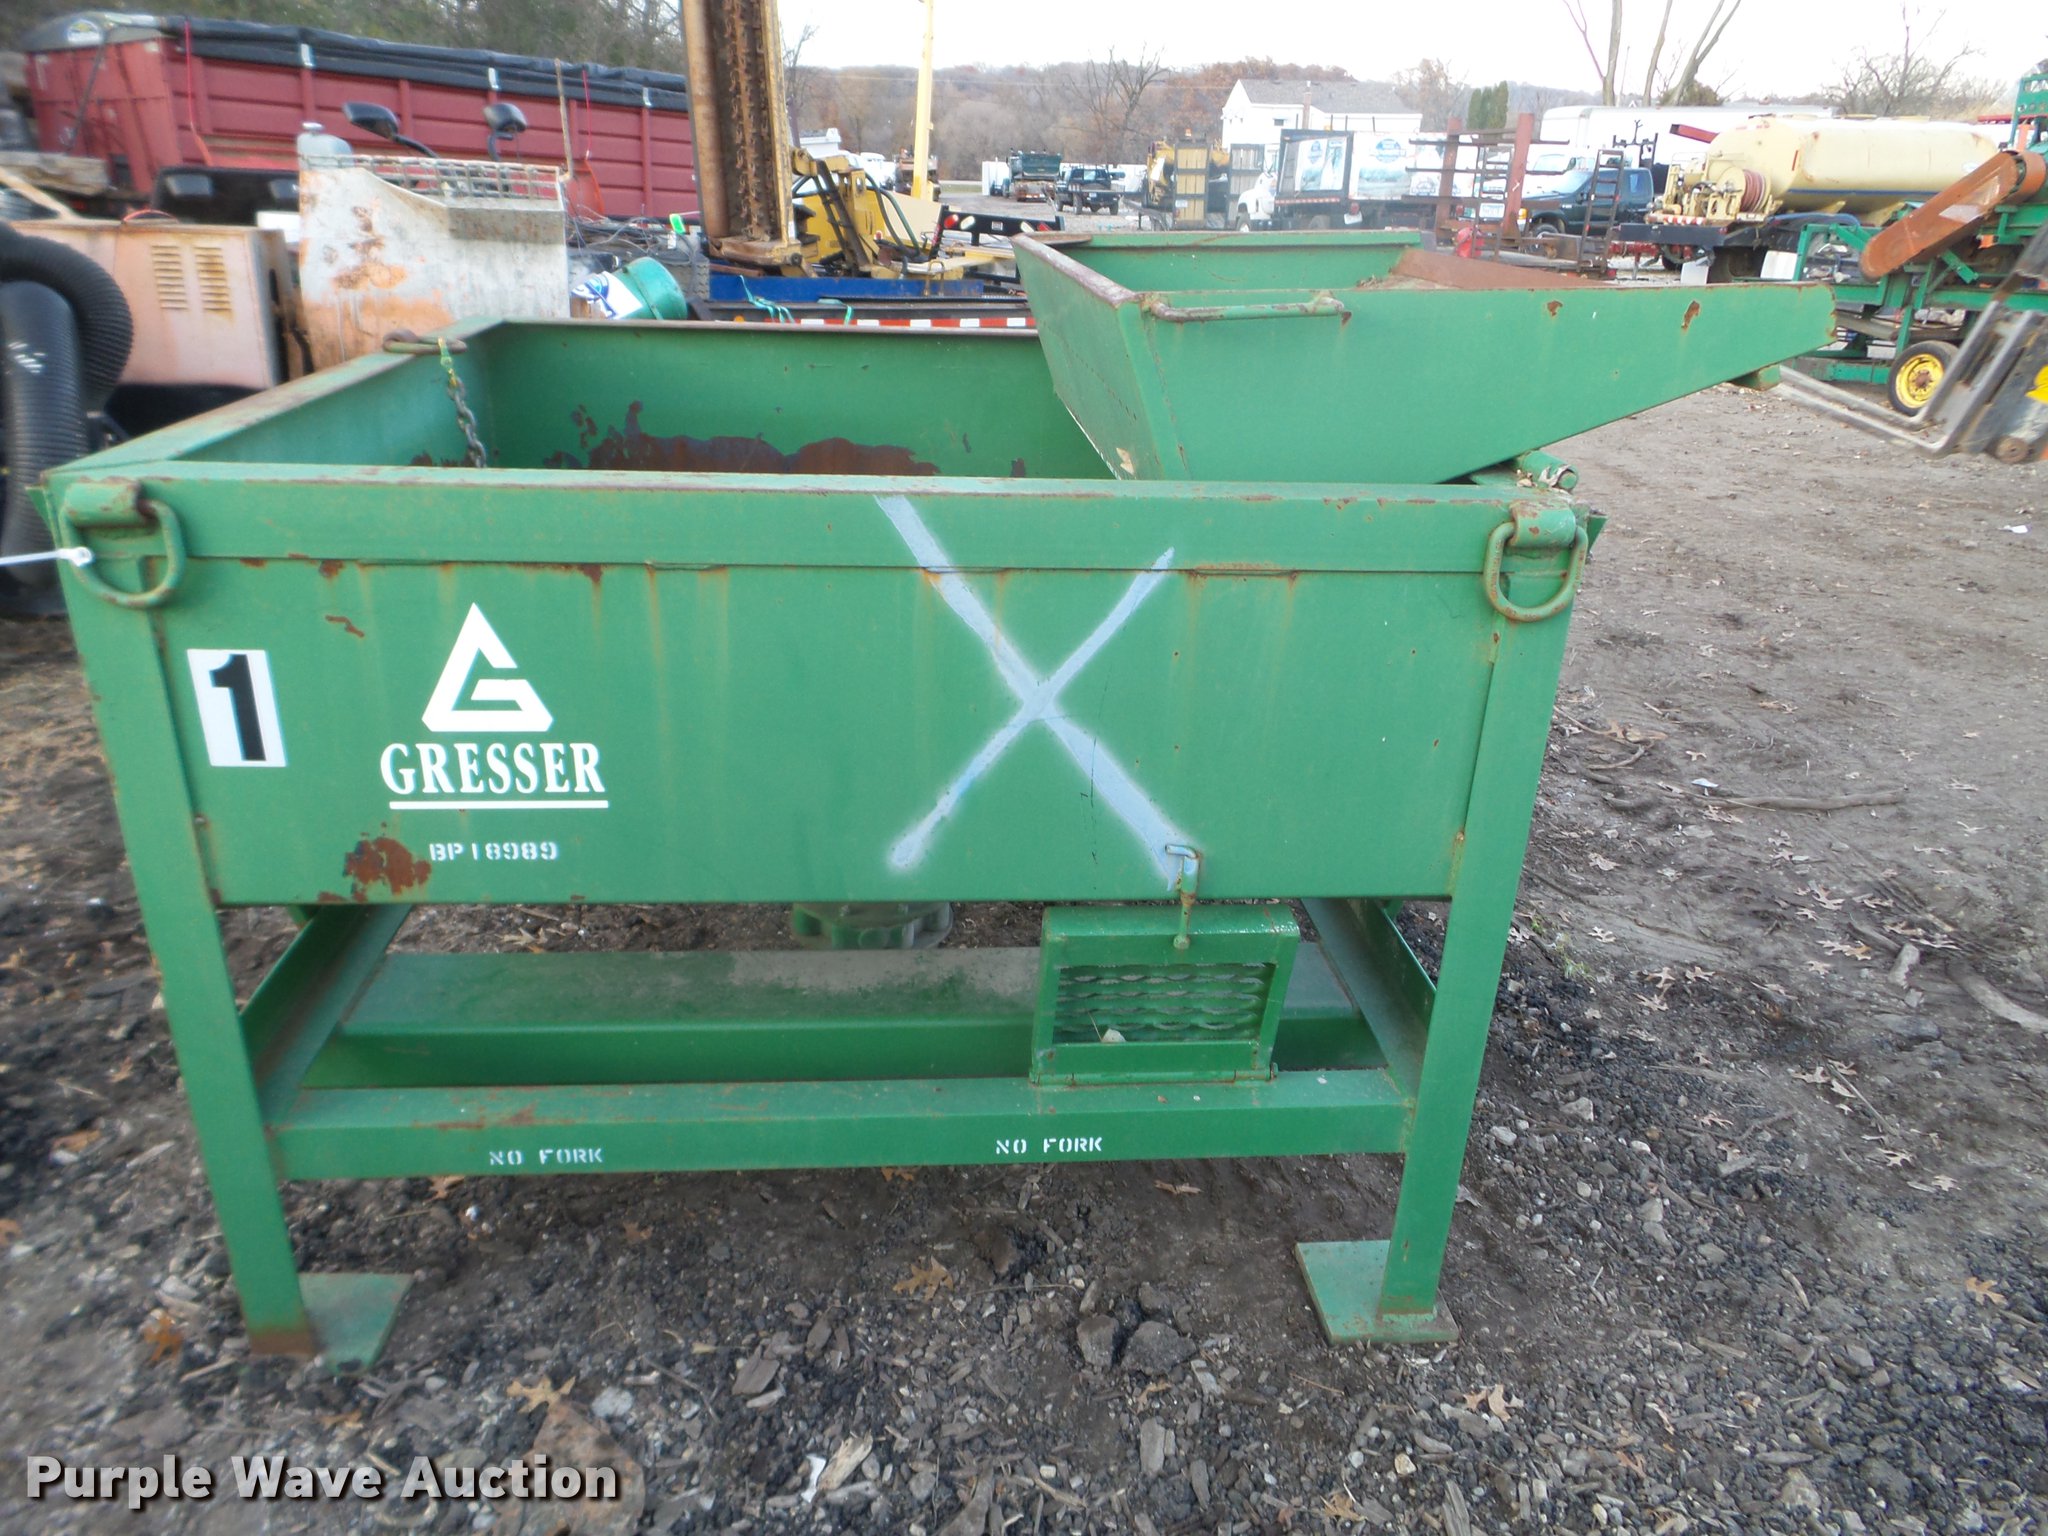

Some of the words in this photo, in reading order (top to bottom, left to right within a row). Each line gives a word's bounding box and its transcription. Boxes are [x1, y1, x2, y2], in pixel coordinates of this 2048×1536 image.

[209, 653, 267, 761] 1
[380, 742, 606, 795] GRESSER
[489, 1150, 524, 1166] NO
[539, 1147, 603, 1165] FORK
[996, 1138, 1027, 1155] NO
[1043, 1136, 1102, 1153] FORK
